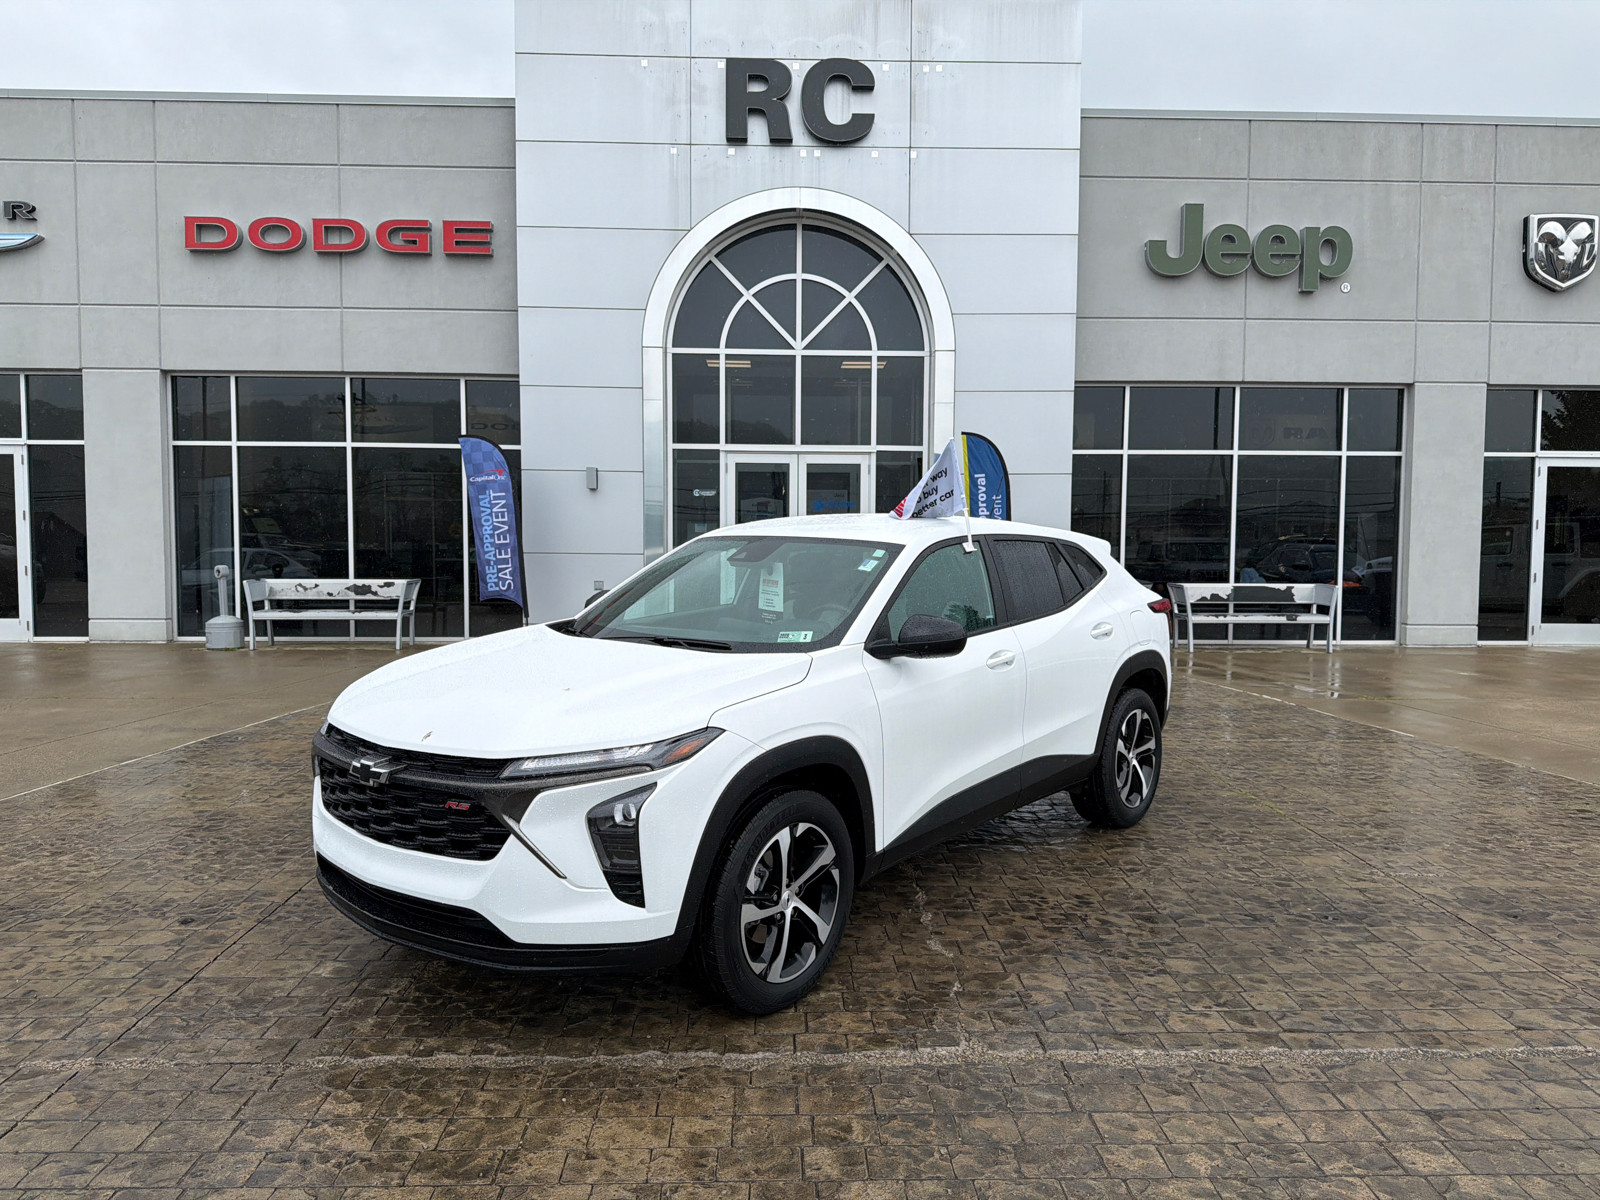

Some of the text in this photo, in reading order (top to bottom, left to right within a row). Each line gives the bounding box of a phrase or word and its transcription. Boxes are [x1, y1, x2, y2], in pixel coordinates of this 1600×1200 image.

[725, 58, 875, 144] RC
[184, 216, 493, 257] DODGE
[1144, 203, 1353, 293] Jeep
[930, 467, 947, 482] way
[922, 485, 938, 499] buy
[939, 489, 954, 502] car
[992, 494, 1003, 520] vent
[478, 490, 500, 592] PRE-APPROVAL
[490, 489, 514, 591] SALE EVENT
[445, 801, 471, 811] RS
